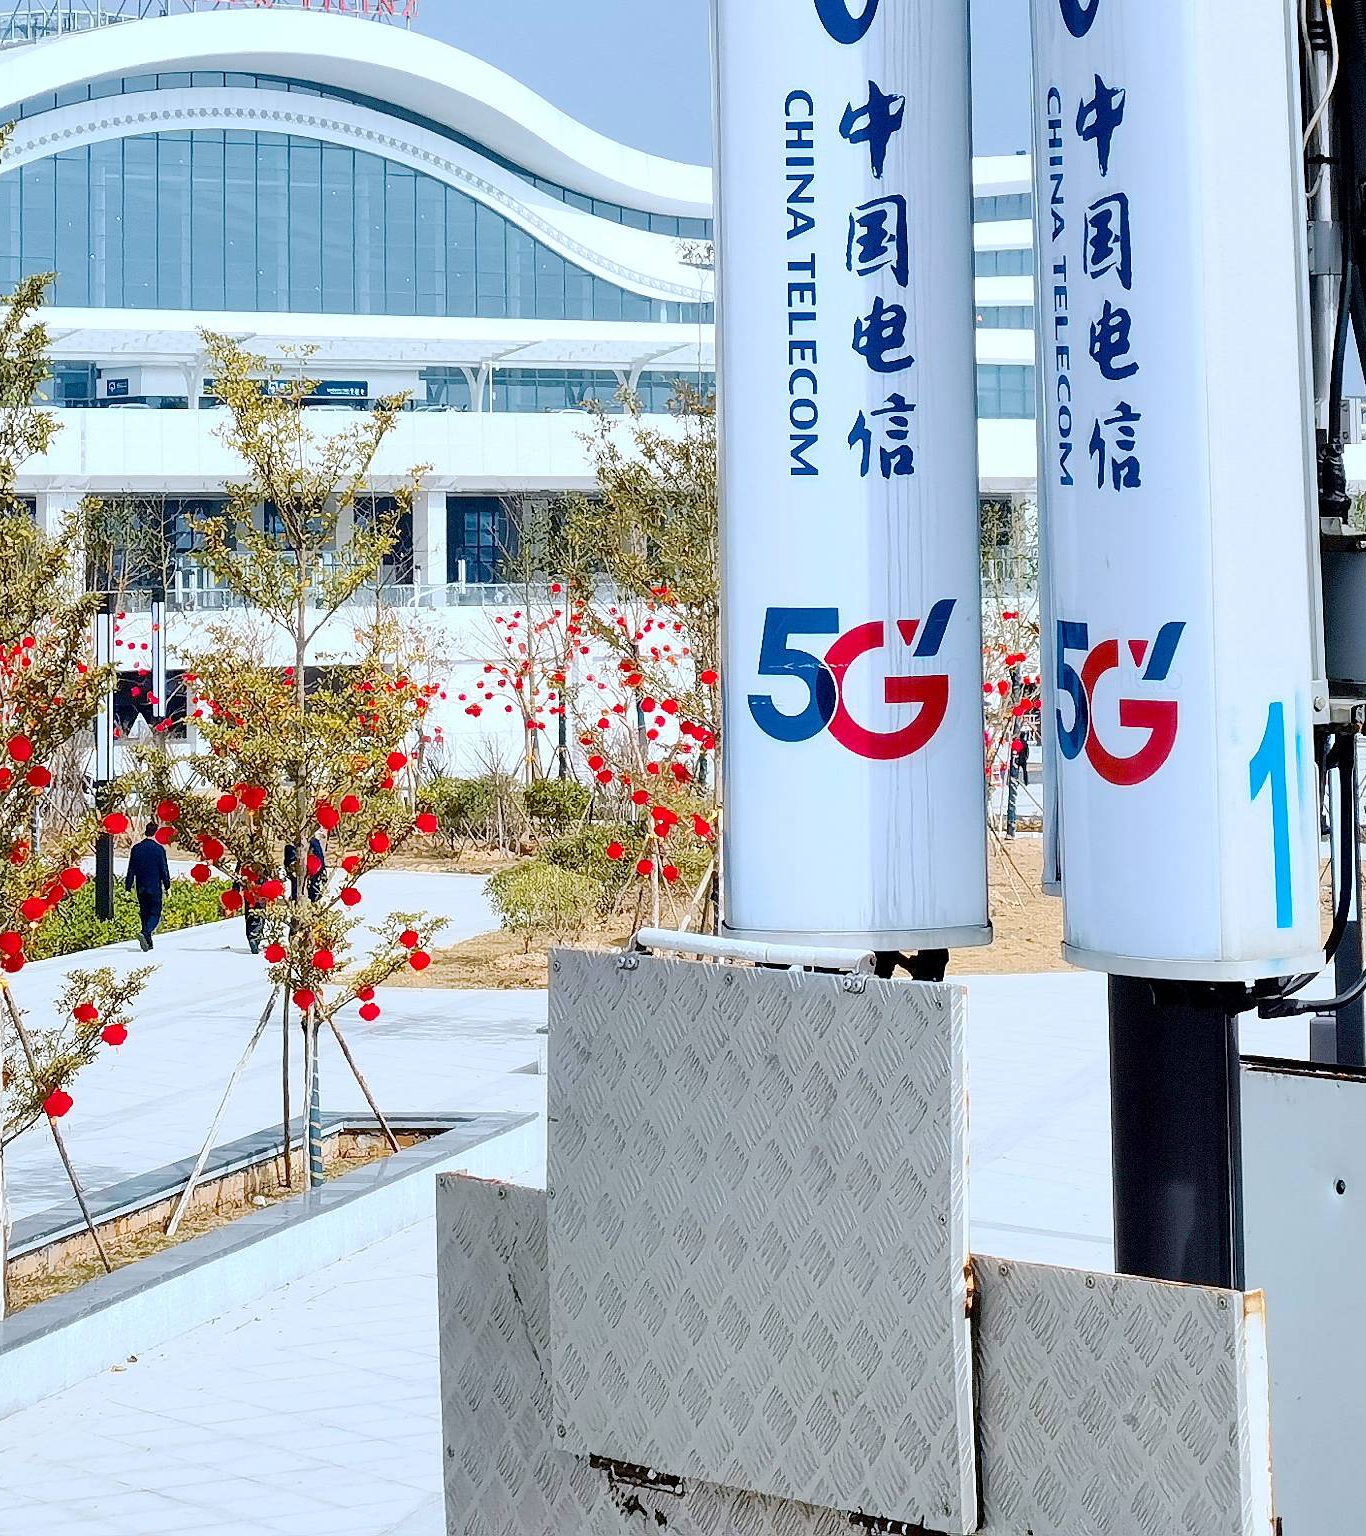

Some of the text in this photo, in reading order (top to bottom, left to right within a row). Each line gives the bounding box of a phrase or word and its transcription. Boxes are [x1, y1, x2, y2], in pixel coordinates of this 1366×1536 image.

[784, 89, 819, 477] CHINA TELECOM
[838, 79, 917, 481] 中国电信
[1047, 87, 1074, 486] CHINA TELECOM
[1076, 73, 1142, 493] 中国电信
[747, 598, 957, 761] 5G
[1249, 701, 1293, 929] 1
